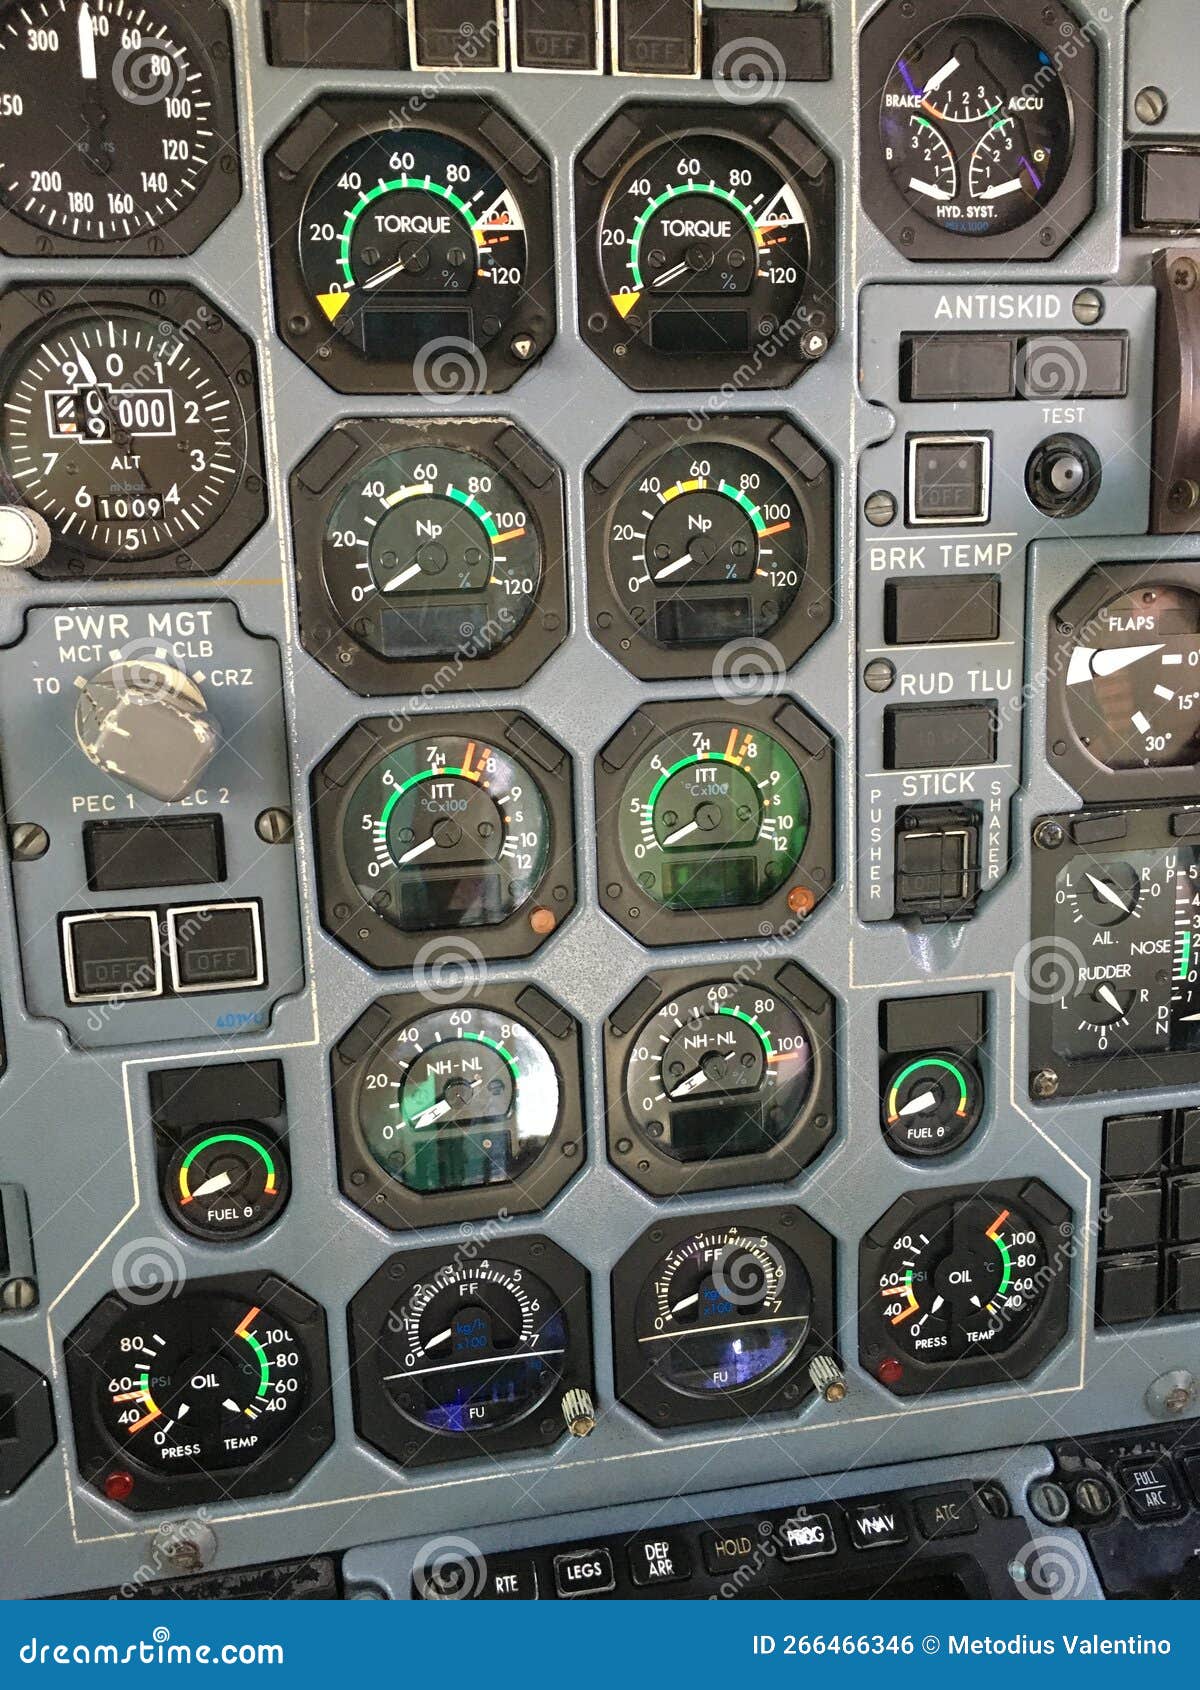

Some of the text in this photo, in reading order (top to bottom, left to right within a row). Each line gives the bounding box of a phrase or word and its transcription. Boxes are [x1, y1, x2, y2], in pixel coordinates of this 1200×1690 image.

[28, 30, 58, 50] 300
[122, 29, 141, 50] 60
[151, 55, 170, 76] 80
[165, 98, 191, 119] 100
[886, 95, 922, 107] BRAKE
[1008, 98, 1043, 110] ACCU
[163, 139, 188, 160] 120
[886, 149, 892, 159] B
[1034, 151, 1044, 161] G
[390, 152, 414, 169] 60
[677, 159, 700, 175] 60
[337, 172, 361, 190] 40
[446, 165, 470, 182] 80
[729, 170, 751, 185] 80
[31, 172, 61, 192] 200
[141, 172, 167, 193] 140
[628, 179, 650, 195] 40
[68, 192, 93, 213] 180
[108, 194, 133, 214] 160
[937, 206, 998, 218] HYD. SYST.
[310, 223, 334, 241] 20
[375, 215, 450, 234] TORQUE
[661, 220, 731, 237] TORQUE
[603, 229, 624, 245] 20
[490, 268, 520, 284] 120
[769, 268, 796, 284] 120
[934, 294, 1061, 319] ANTISKID
[62, 362, 78, 384] 9
[106, 354, 123, 376] 0
[154, 361, 163, 384] 1
[118, 399, 164, 427] 000
[184, 402, 200, 423] 2
[1042, 408, 1085, 424] TEST
[42, 452, 59, 474] 7
[110, 456, 141, 470] ALT
[191, 450, 206, 472] 3
[690, 460, 710, 476] 60
[414, 463, 437, 480] 60
[361, 481, 384, 497] 40
[468, 477, 491, 493] 80
[639, 477, 660, 493] 40
[740, 474, 760, 489] 80
[75, 486, 91, 507] 6
[164, 483, 180, 504] 4
[100, 498, 160, 518] 1009
[764, 504, 790, 520] 100
[496, 512, 525, 529] 100
[688, 515, 712, 532] Np
[416, 520, 442, 538] Np
[613, 525, 633, 540] 20
[124, 529, 139, 550] 5
[332, 531, 355, 547] 20
[870, 543, 1012, 571] BRK TEMP
[726, 564, 736, 579] %
[770, 571, 797, 587] 120
[504, 579, 532, 594] 120
[629, 577, 640, 592] 0
[352, 586, 363, 602] 0
[54, 611, 213, 641] PWR MGT
[1109, 617, 1154, 631] FLAPS
[59, 646, 102, 663] MCT
[172, 641, 213, 658] CLB
[211, 669, 253, 686] CRZ
[901, 669, 1012, 696] RUD TLU
[33, 678, 60, 694] TO
[383, 770, 394, 785] 6
[696, 768, 717, 783] ITT
[431, 783, 454, 798] ITT
[903, 772, 976, 796] STICK
[166, 788, 230, 806] EC 2
[511, 787, 522, 801] 9
[72, 794, 134, 812] PEC 1
[777, 816, 793, 829] 10
[988, 782, 1001, 878] SHAKER
[521, 833, 537, 846] 10
[774, 837, 788, 850] 12
[870, 790, 882, 898] PUSHER
[516, 855, 532, 869] 12
[1066, 874, 1073, 886] L
[1142, 868, 1150, 881] R
[1092, 932, 1119, 945] AIL.
[1131, 940, 1171, 955] NOSE
[198, 952, 236, 970] OFF
[1079, 965, 1131, 982] RUDDER
[707, 986, 728, 1001] 60
[1141, 990, 1148, 1002] R
[659, 1003, 678, 1017] 40
[755, 999, 774, 1013] 80
[1062, 997, 1068, 1009] L
[450, 1010, 471, 1025] 60
[397, 1028, 419, 1043] 40
[778, 1036, 804, 1051] 100
[1098, 1036, 1107, 1049] 0
[366, 1074, 387, 1089] 20
[908, 1128, 932, 1139] FUEL
[208, 1208, 239, 1221] FUEL
[1011, 1231, 1036, 1245] 100
[705, 1249, 722, 1262] FF
[1017, 1255, 1036, 1267] 80
[880, 1273, 898, 1286] 60
[949, 1270, 972, 1284] OIL
[1014, 1278, 1033, 1291] 60
[459, 1283, 478, 1295] FF
[883, 1303, 902, 1316] 40
[121, 1336, 143, 1352] 80
[915, 1336, 947, 1350] PRESS
[967, 1330, 995, 1342] TEMP
[276, 1353, 298, 1367] 80
[108, 1377, 131, 1392] 60
[191, 1374, 219, 1389] OIL
[275, 1378, 298, 1393] 60
[714, 1372, 728, 1383] FU
[266, 1397, 287, 1412] 40
[118, 1409, 140, 1424] 40
[470, 1407, 484, 1419] FU
[224, 1436, 258, 1450] TEMP
[162, 1444, 200, 1459] PRESS
[1133, 1470, 1159, 1485] FULL
[1146, 1491, 1166, 1507] ARC
[935, 1504, 959, 1522] ATC
[644, 1542, 669, 1560] DEP
[715, 1537, 752, 1558] HOLD
[567, 1562, 602, 1580] LEGS
[650, 1559, 673, 1577] ARR
[496, 1575, 518, 1594] RTE
